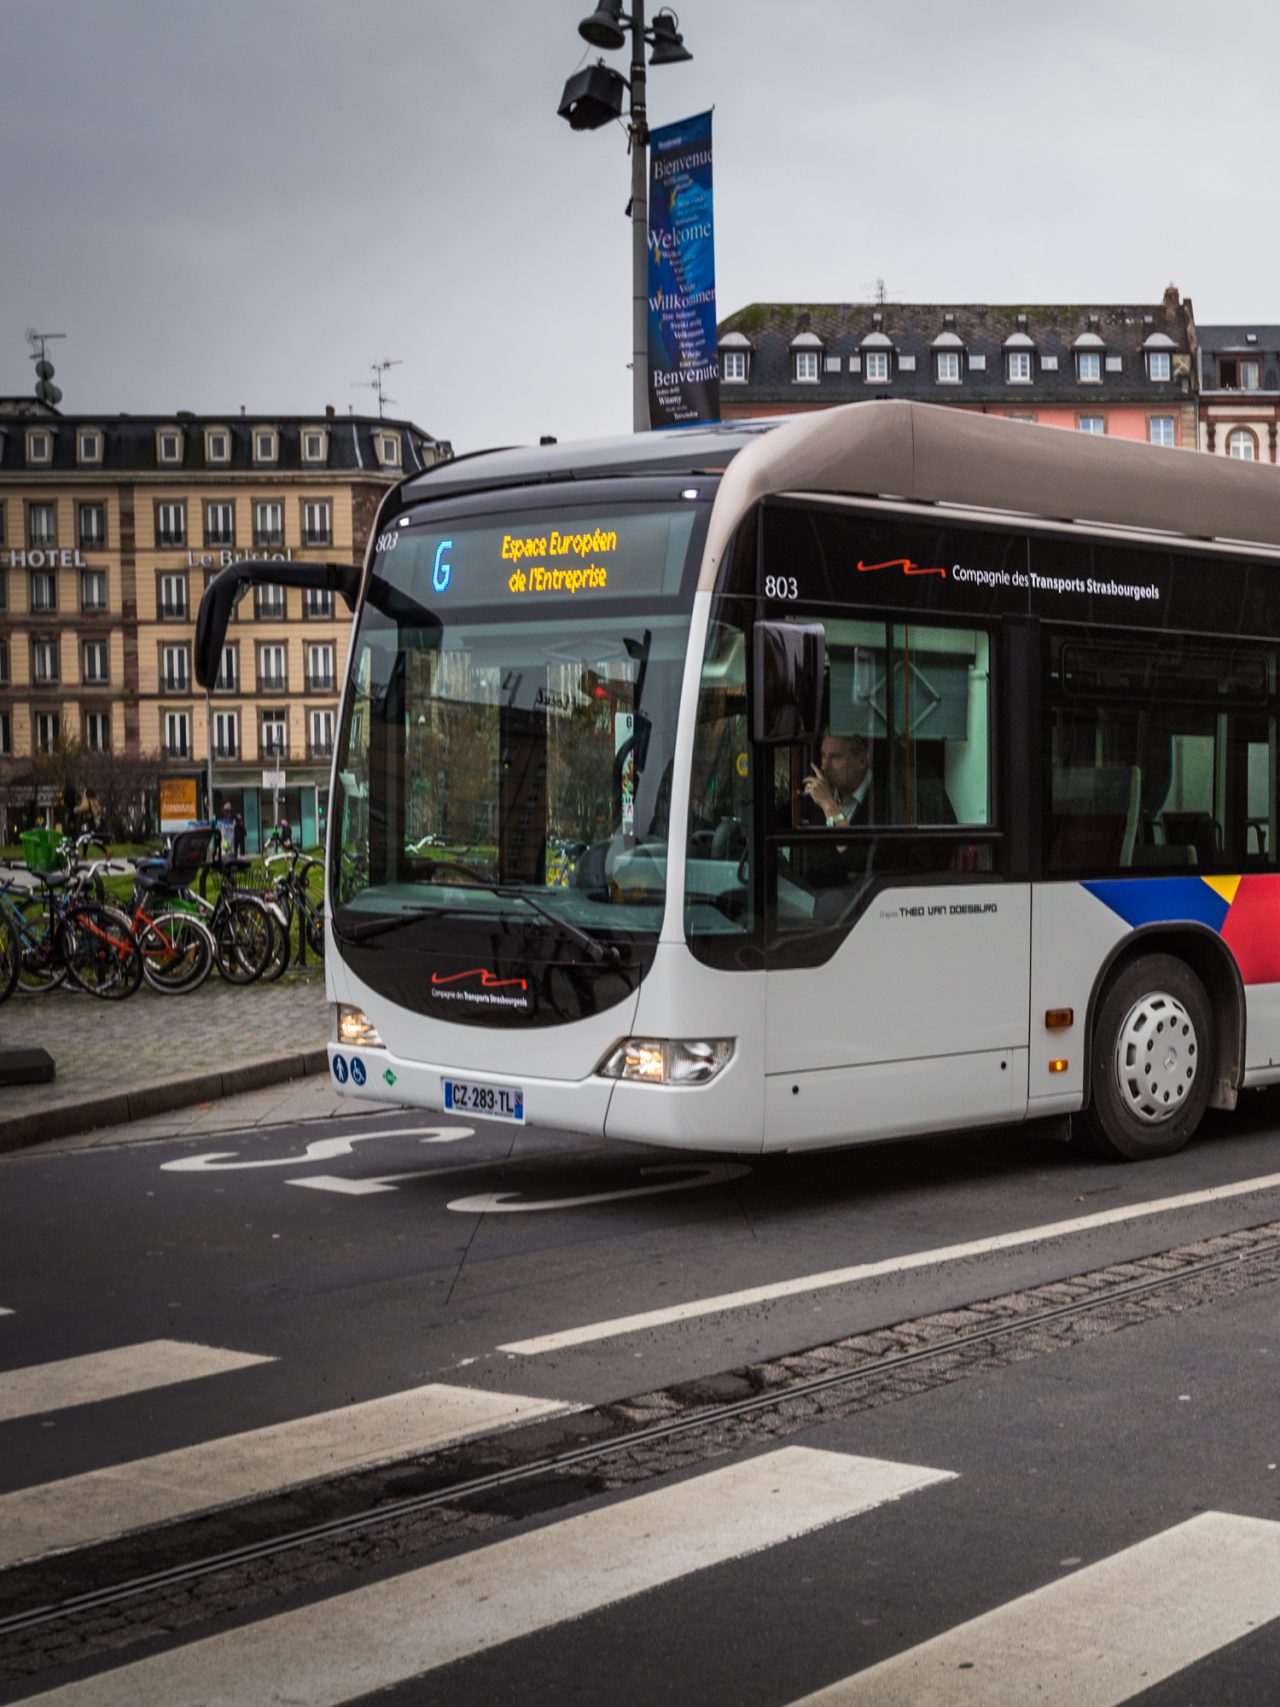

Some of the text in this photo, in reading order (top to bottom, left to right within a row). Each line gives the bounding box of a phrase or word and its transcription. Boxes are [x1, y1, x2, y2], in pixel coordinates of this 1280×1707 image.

[647, 222, 711, 250] Welcome
[375, 531, 399, 552] 803
[502, 528, 617, 563] Espace Européen
[187, 550, 213, 567] Le
[432, 540, 453, 592] G
[508, 563, 607, 594] de l'Entreprise
[765, 576, 798, 600] 803
[952, 564, 1160, 602] Compagnie des Transports Strasbourgeois
[899, 906, 925, 917] THEO
[927, 905, 947, 916] VAN
